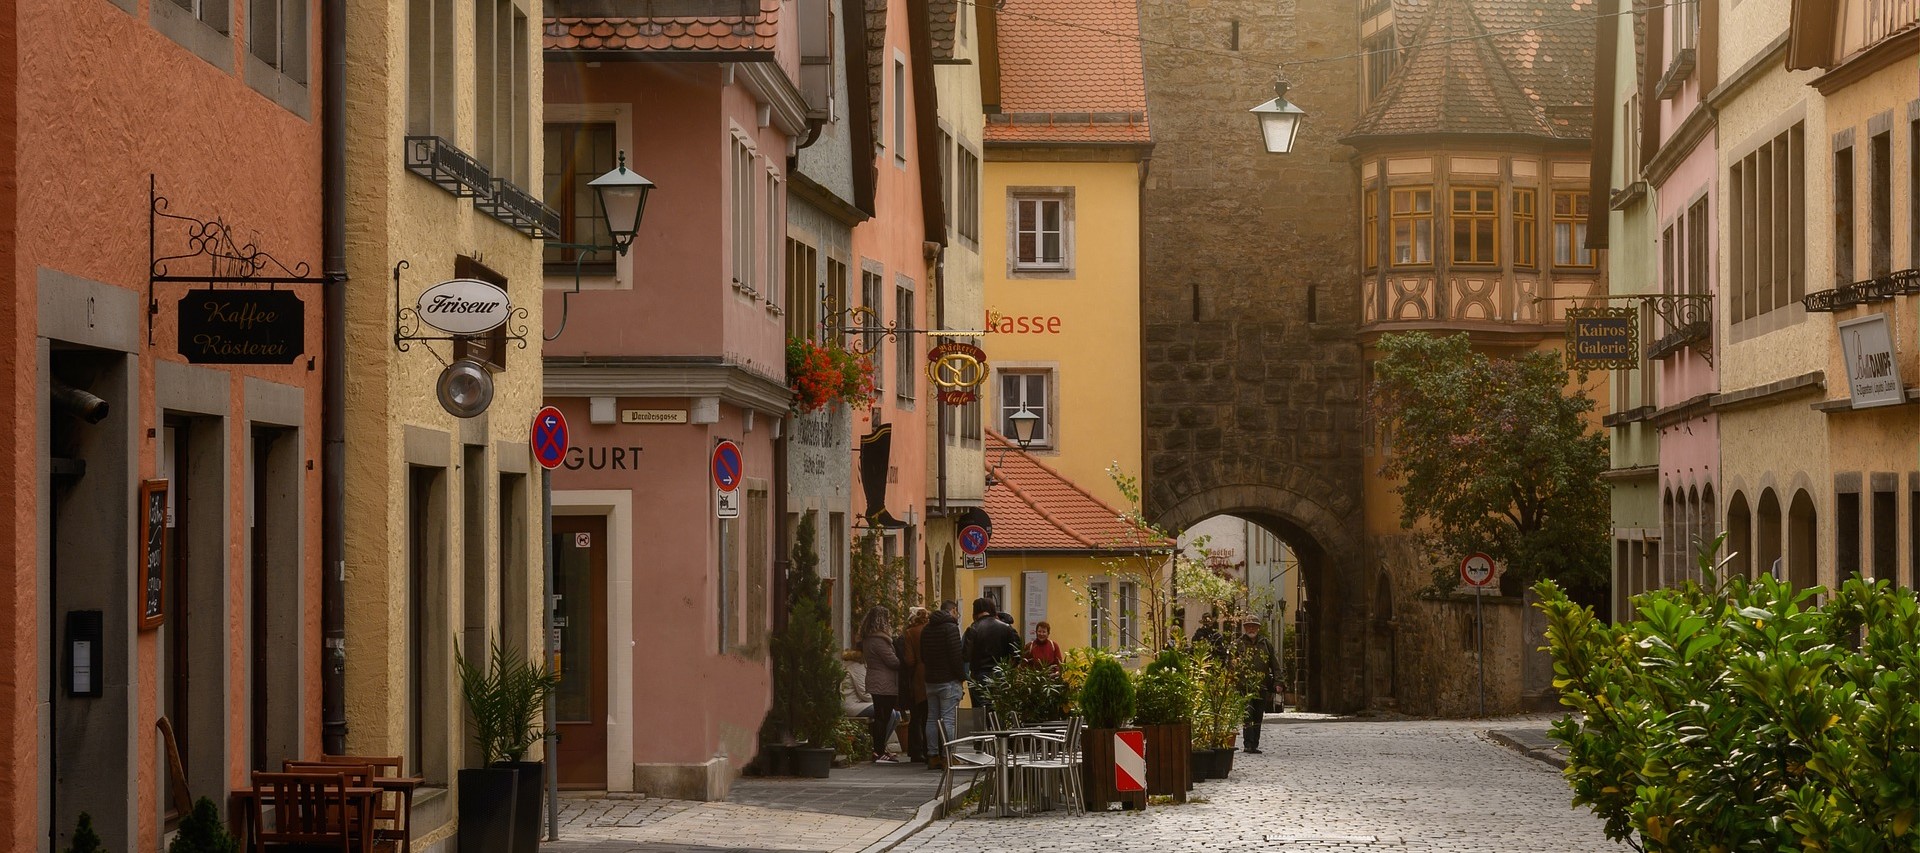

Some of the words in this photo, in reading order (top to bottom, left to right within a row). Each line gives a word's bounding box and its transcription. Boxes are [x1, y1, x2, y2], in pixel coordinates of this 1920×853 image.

[427, 294, 500, 314] Friseur
[203, 302, 278, 329] Kaffee
[985, 310, 1062, 334] kasse
[1579, 323, 1626, 337] Kairos
[193, 334, 288, 356] Rösterei
[939, 343, 977, 356] Bäckerei
[1579, 341, 1626, 354] Galerie
[562, 446, 643, 471] GURT
